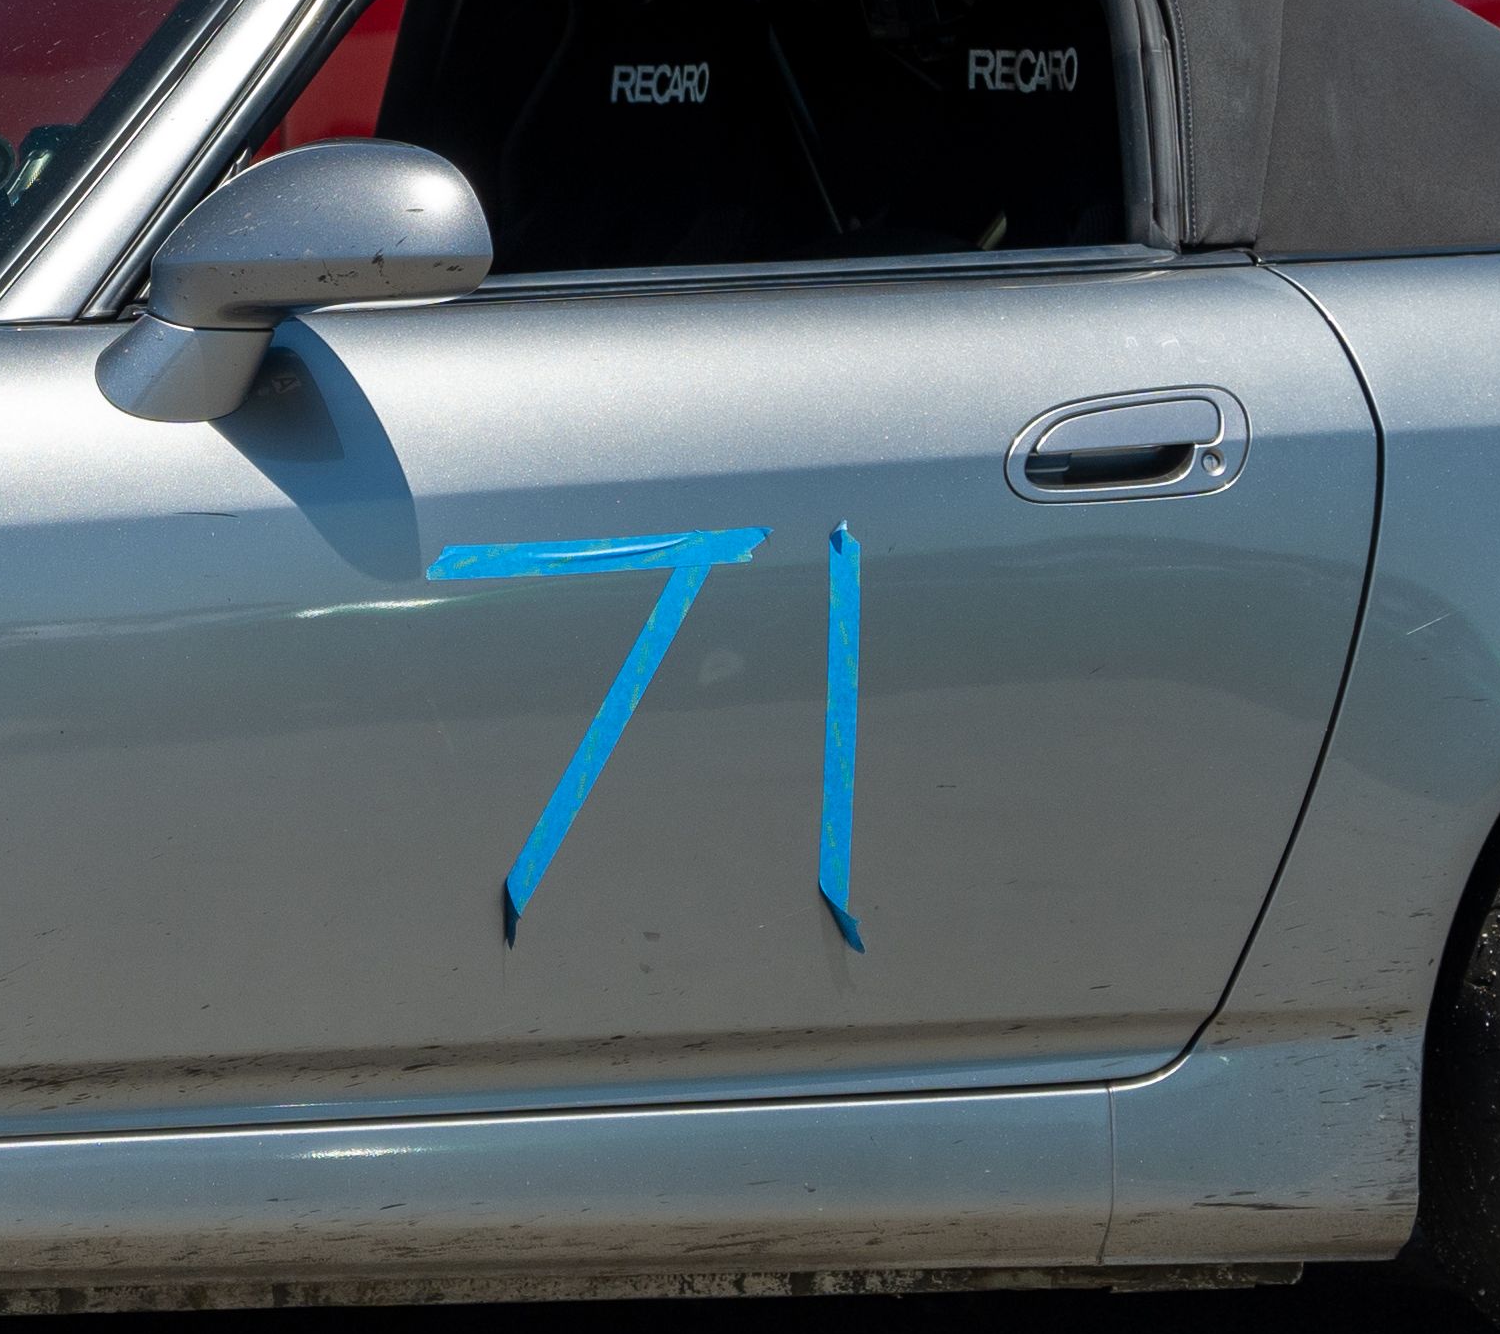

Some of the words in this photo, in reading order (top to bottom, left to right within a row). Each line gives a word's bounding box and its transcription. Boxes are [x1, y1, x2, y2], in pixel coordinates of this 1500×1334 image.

[611, 62, 709, 104] RECARO
[968, 47, 1078, 94] RECARO
[424, 519, 866, 955] 71
